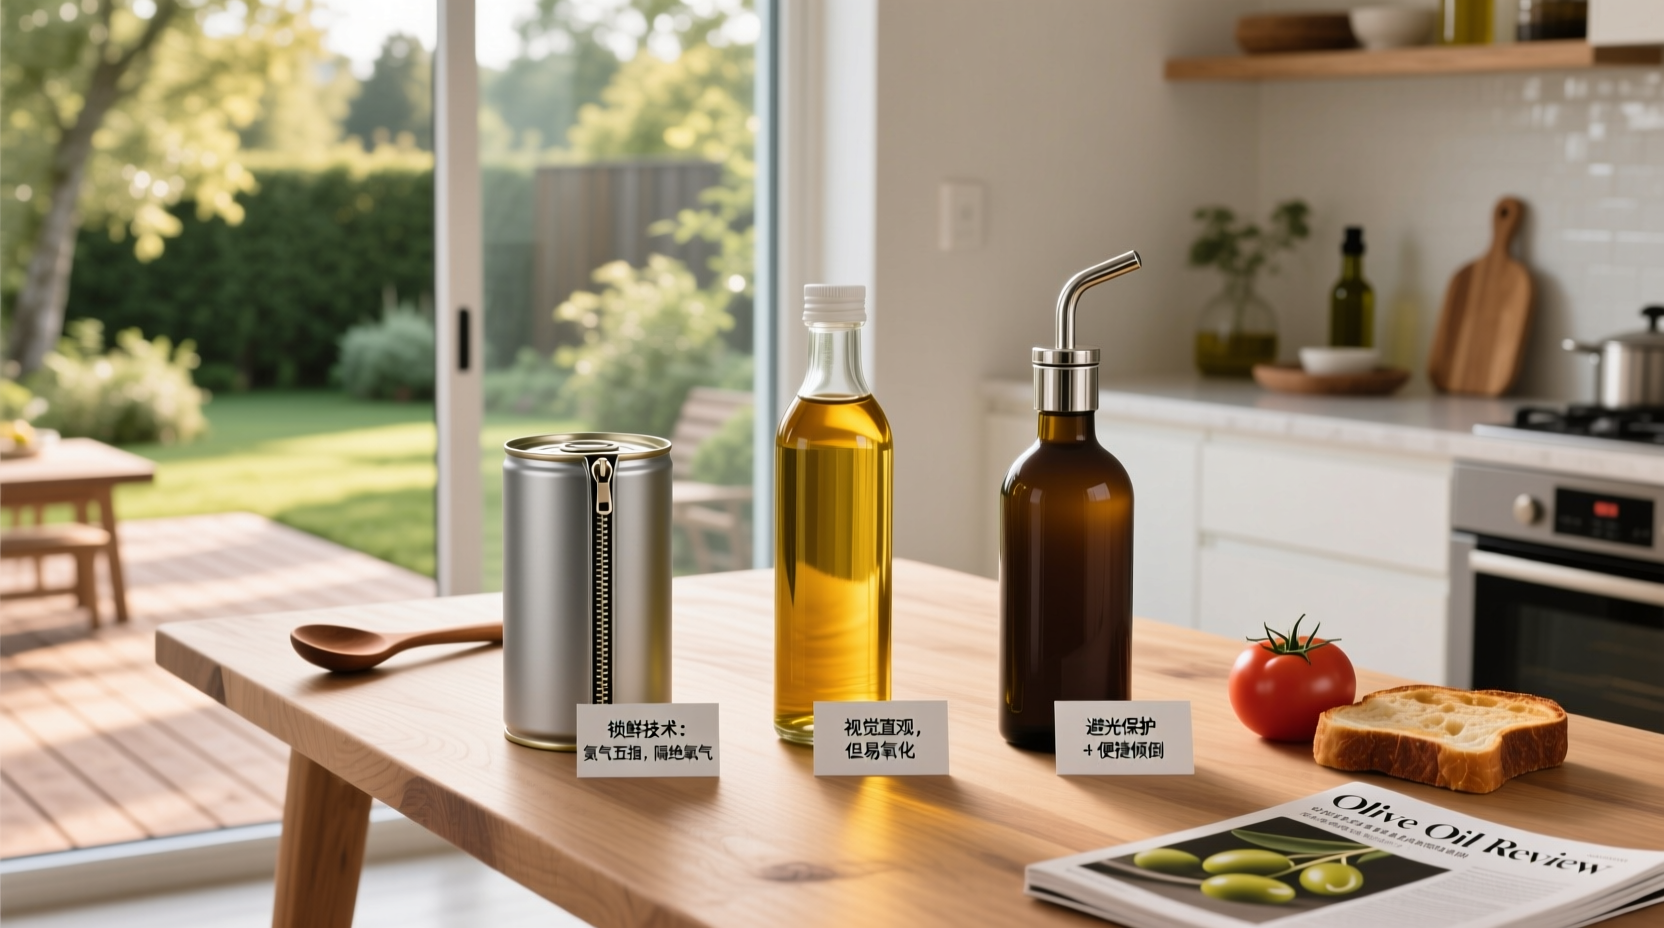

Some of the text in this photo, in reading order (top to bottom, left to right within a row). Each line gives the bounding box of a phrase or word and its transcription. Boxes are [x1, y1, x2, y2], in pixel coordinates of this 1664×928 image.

[844, 717, 921, 738] 视觉直观，
[845, 740, 916, 761] 但易氧化
[1332, 794, 1418, 830] Olive
[1425, 823, 1486, 848] Oil
[1482, 837, 1613, 875] Review
